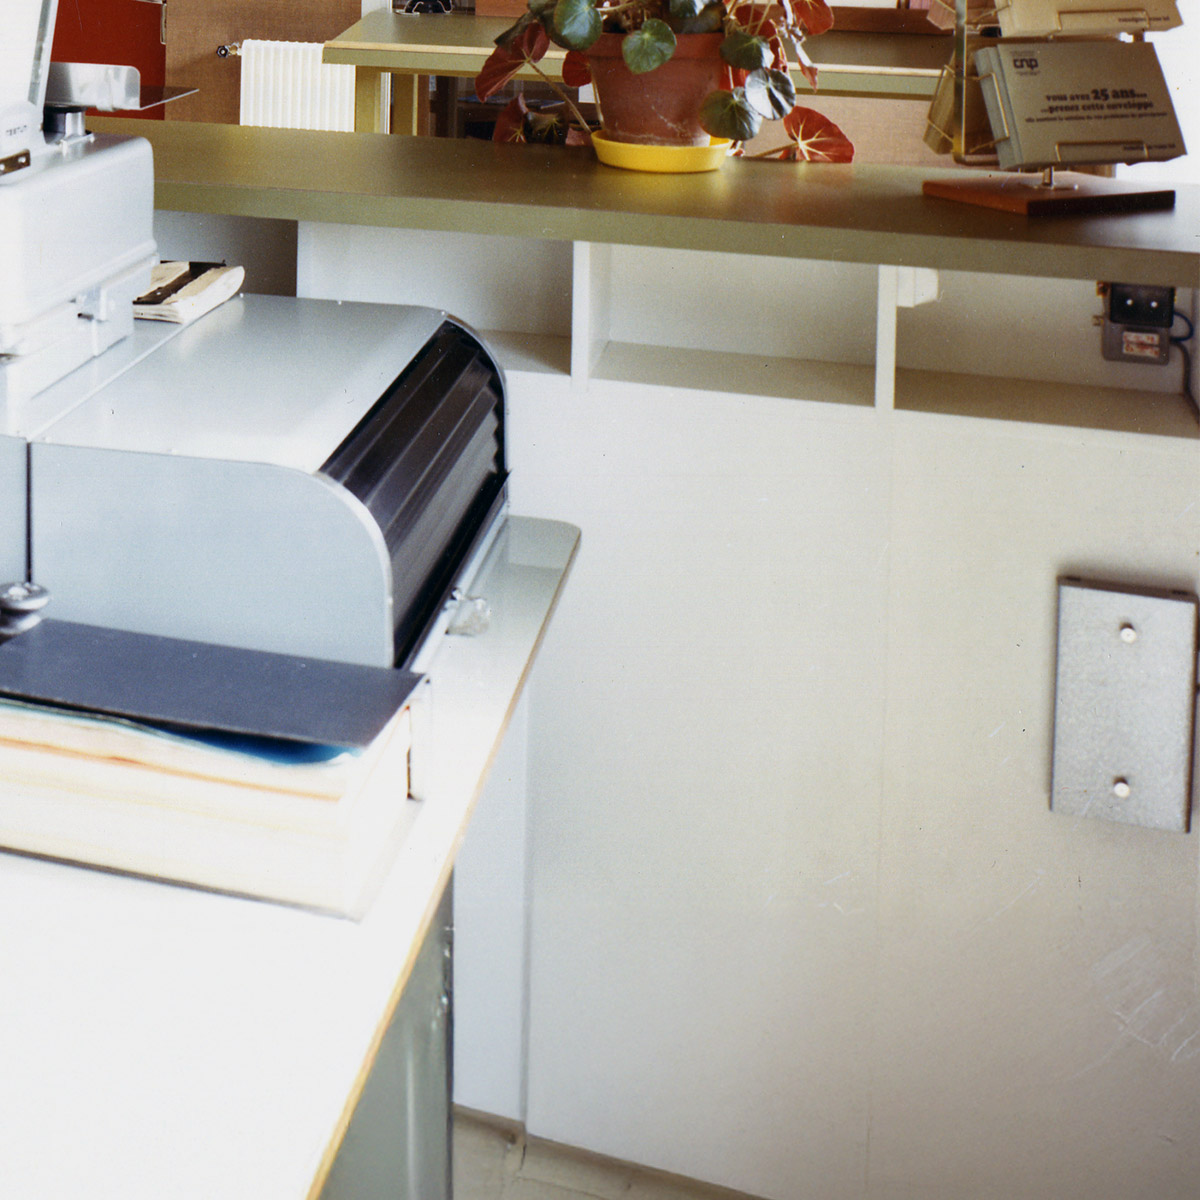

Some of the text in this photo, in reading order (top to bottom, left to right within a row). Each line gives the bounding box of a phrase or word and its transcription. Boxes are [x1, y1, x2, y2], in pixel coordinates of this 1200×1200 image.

[1013, 58, 1039, 70] cnp
[1045, 94, 1068, 102] vous
[1070, 93, 1090, 101] avez
[1091, 88, 1110, 101] 25
[1082, 103, 1104, 111] cette
[1106, 101, 1154, 111] enveloppe
